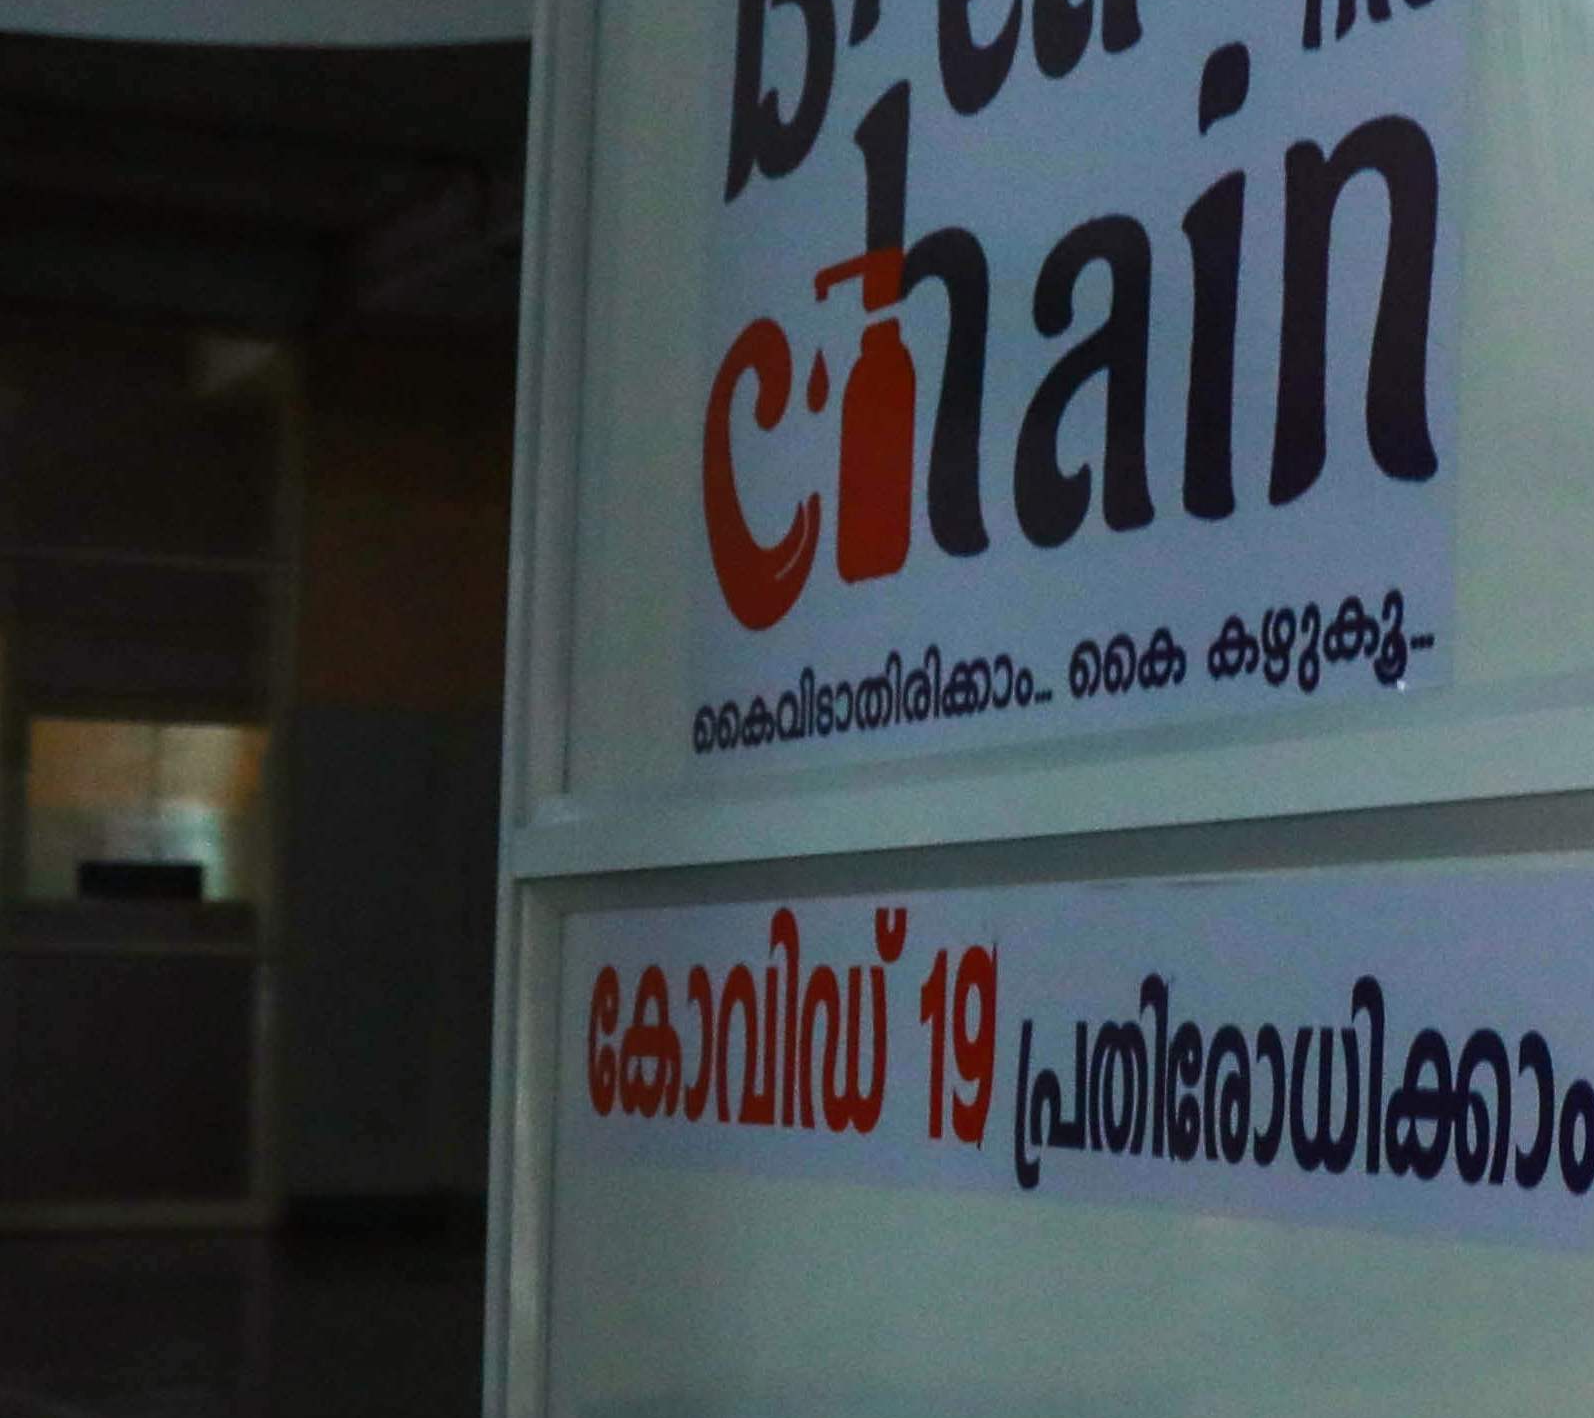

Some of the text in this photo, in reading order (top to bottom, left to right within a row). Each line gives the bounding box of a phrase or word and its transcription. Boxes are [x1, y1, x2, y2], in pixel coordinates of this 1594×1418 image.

[1068, 626, 1188, 699] കൈ
[587, 906, 908, 1134] കോവിഡ്
[919, 943, 998, 1150] 19
